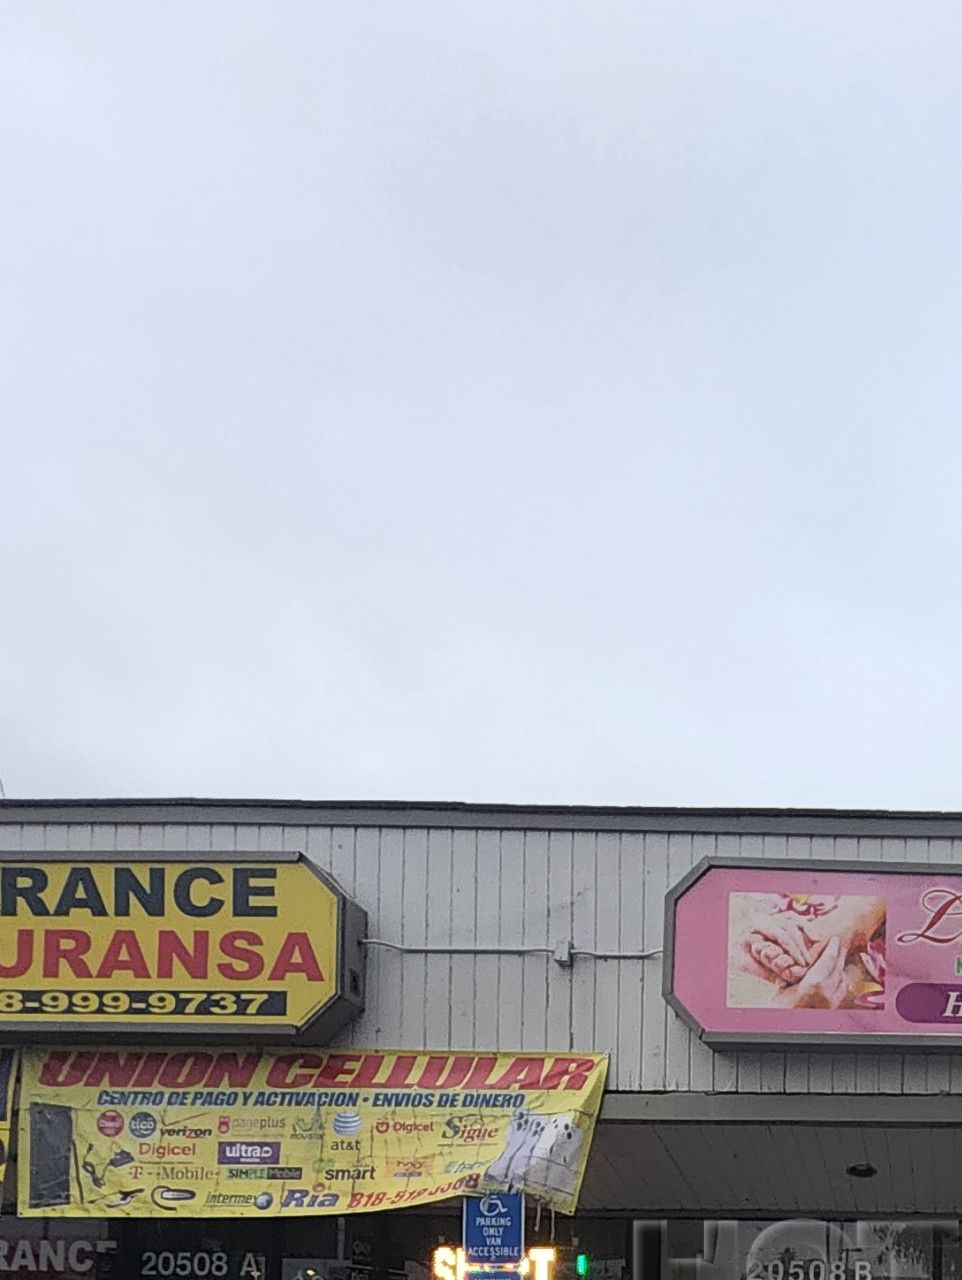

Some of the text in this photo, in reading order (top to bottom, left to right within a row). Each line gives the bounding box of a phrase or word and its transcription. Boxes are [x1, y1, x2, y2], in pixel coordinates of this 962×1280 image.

[1, 867, 278, 917] RANCE
[0, 929, 325, 982] URANSA
[0, 991, 269, 1015] 8-999-9737
[39, 1051, 595, 1091] UNION CELLULAR
[97, 1090, 526, 1109] CENTRO DE PAGO Y ACTIVACION ENVIOS DE DINERO
[160, 1126, 212, 1139] verizon
[393, 1121, 434, 1134] Digicel
[441, 1116, 499, 1143] Sigue
[139, 1142, 196, 1158] Digicel
[330, 1140, 361, 1152] at&t
[324, 1165, 376, 1181] smart
[281, 1183, 340, 1208] Ria
[475, 1217, 512, 1227] PARKING
[482, 1227, 504, 1237] ONLY
[486, 1237, 501, 1246] VAN
[468, 1247, 519, 1257] ACCESSIBLE
[141, 1252, 257, 1276] 20508 A
